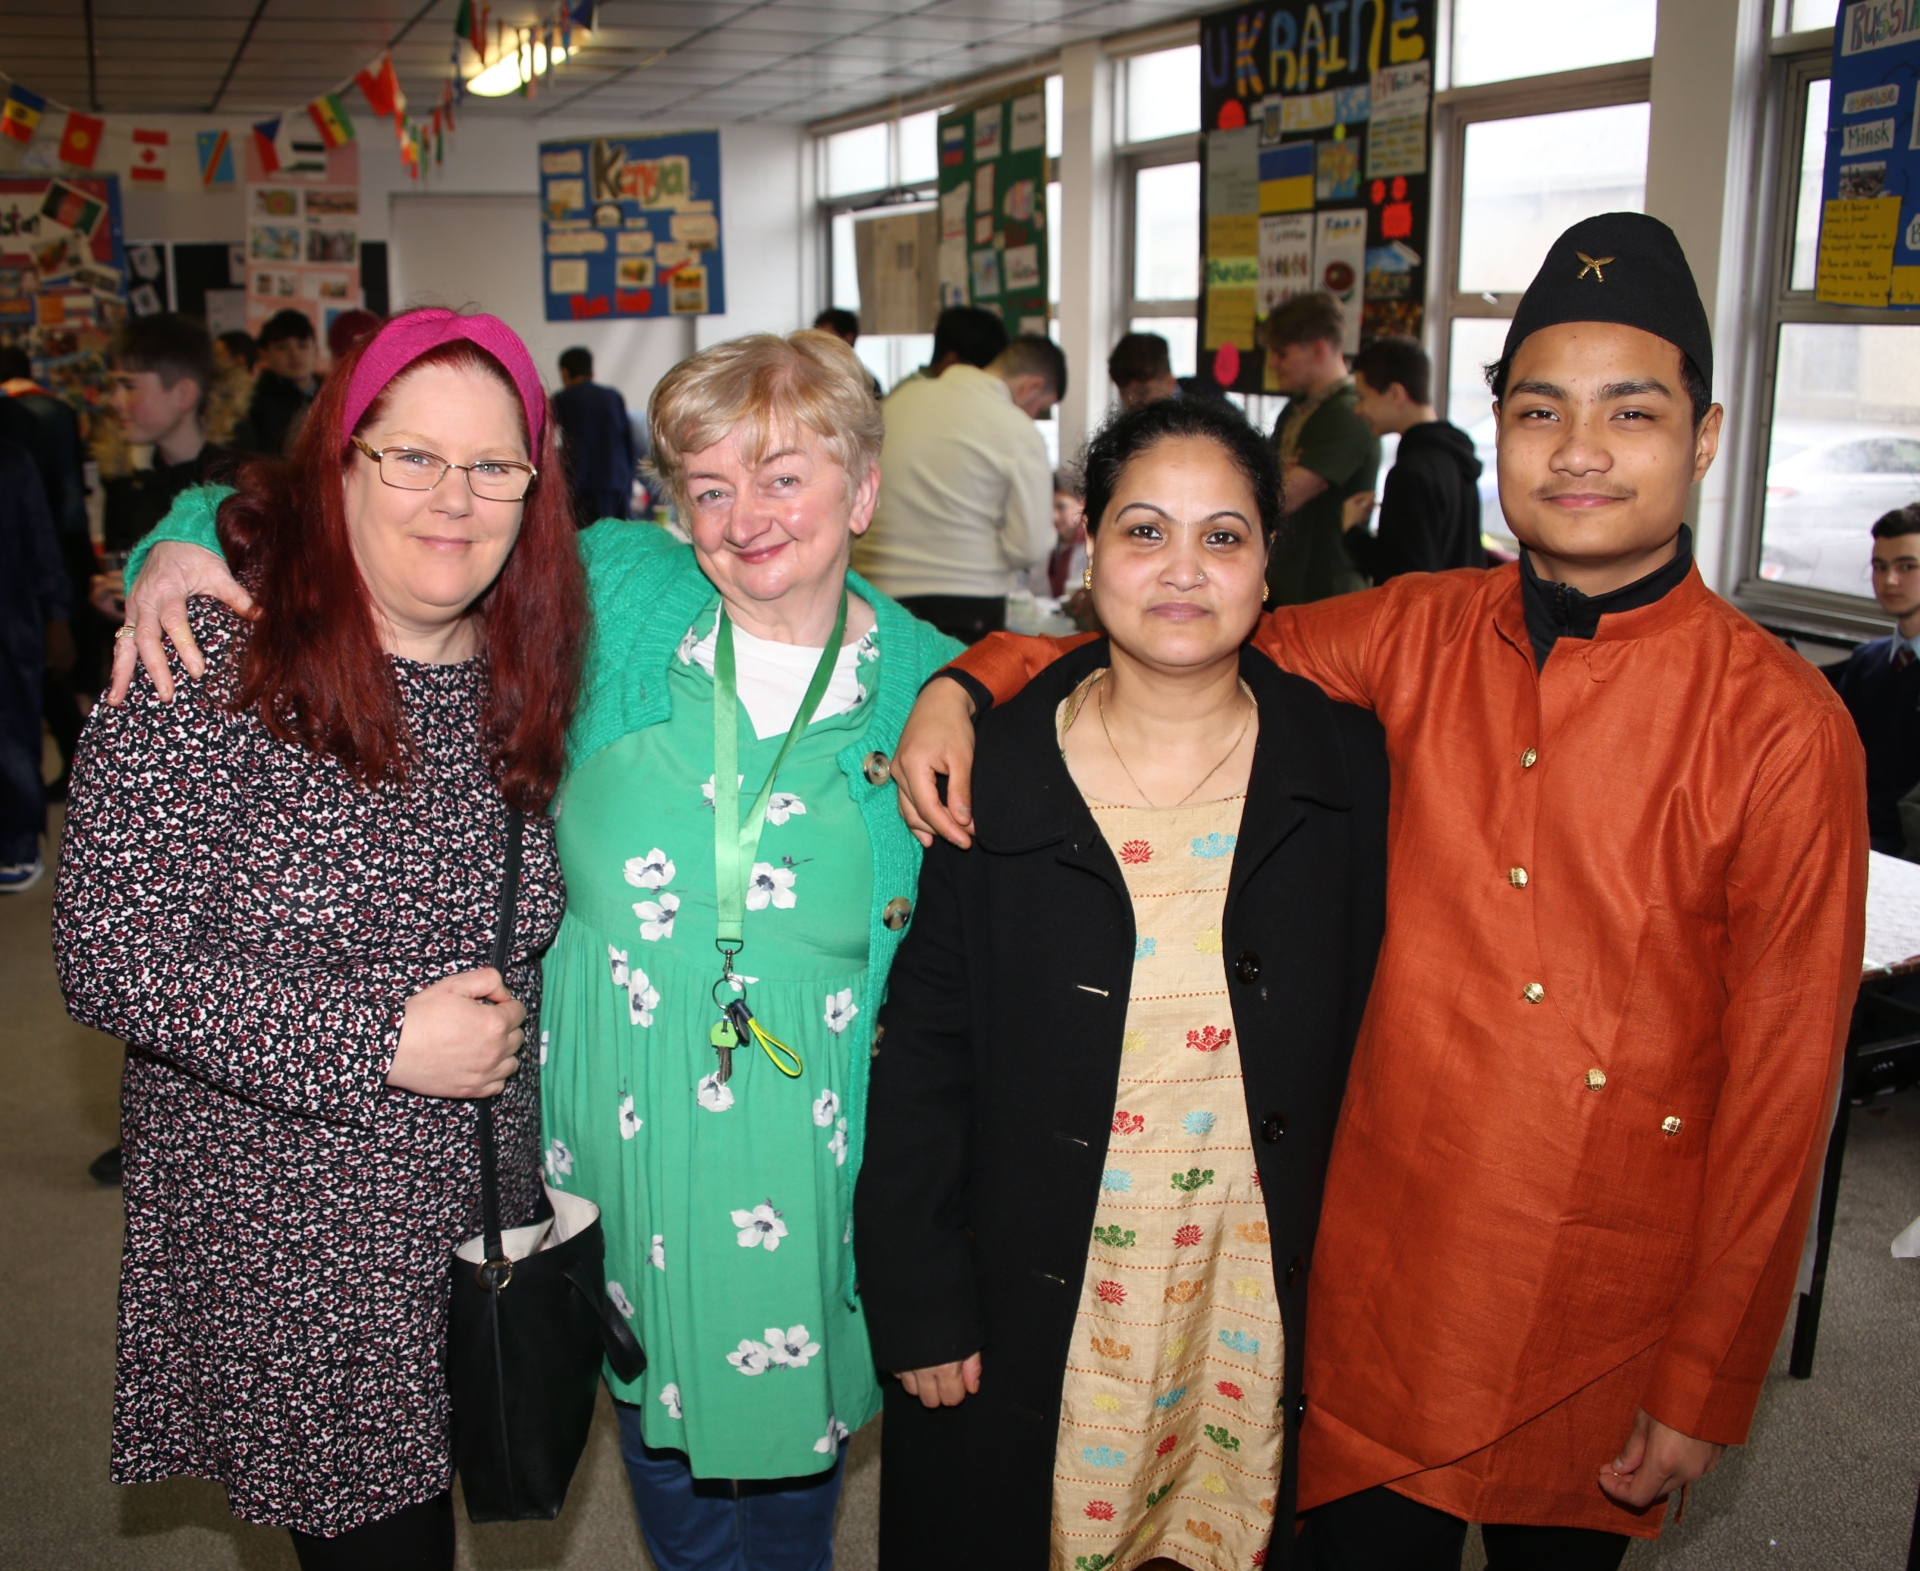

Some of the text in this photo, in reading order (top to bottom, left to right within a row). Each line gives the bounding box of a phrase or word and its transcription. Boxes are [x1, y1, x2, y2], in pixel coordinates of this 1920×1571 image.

[1205, 0, 1426, 97] UKRAINE
[1848, 120, 1890, 149] Minsk
[592, 140, 684, 205] Kenya
